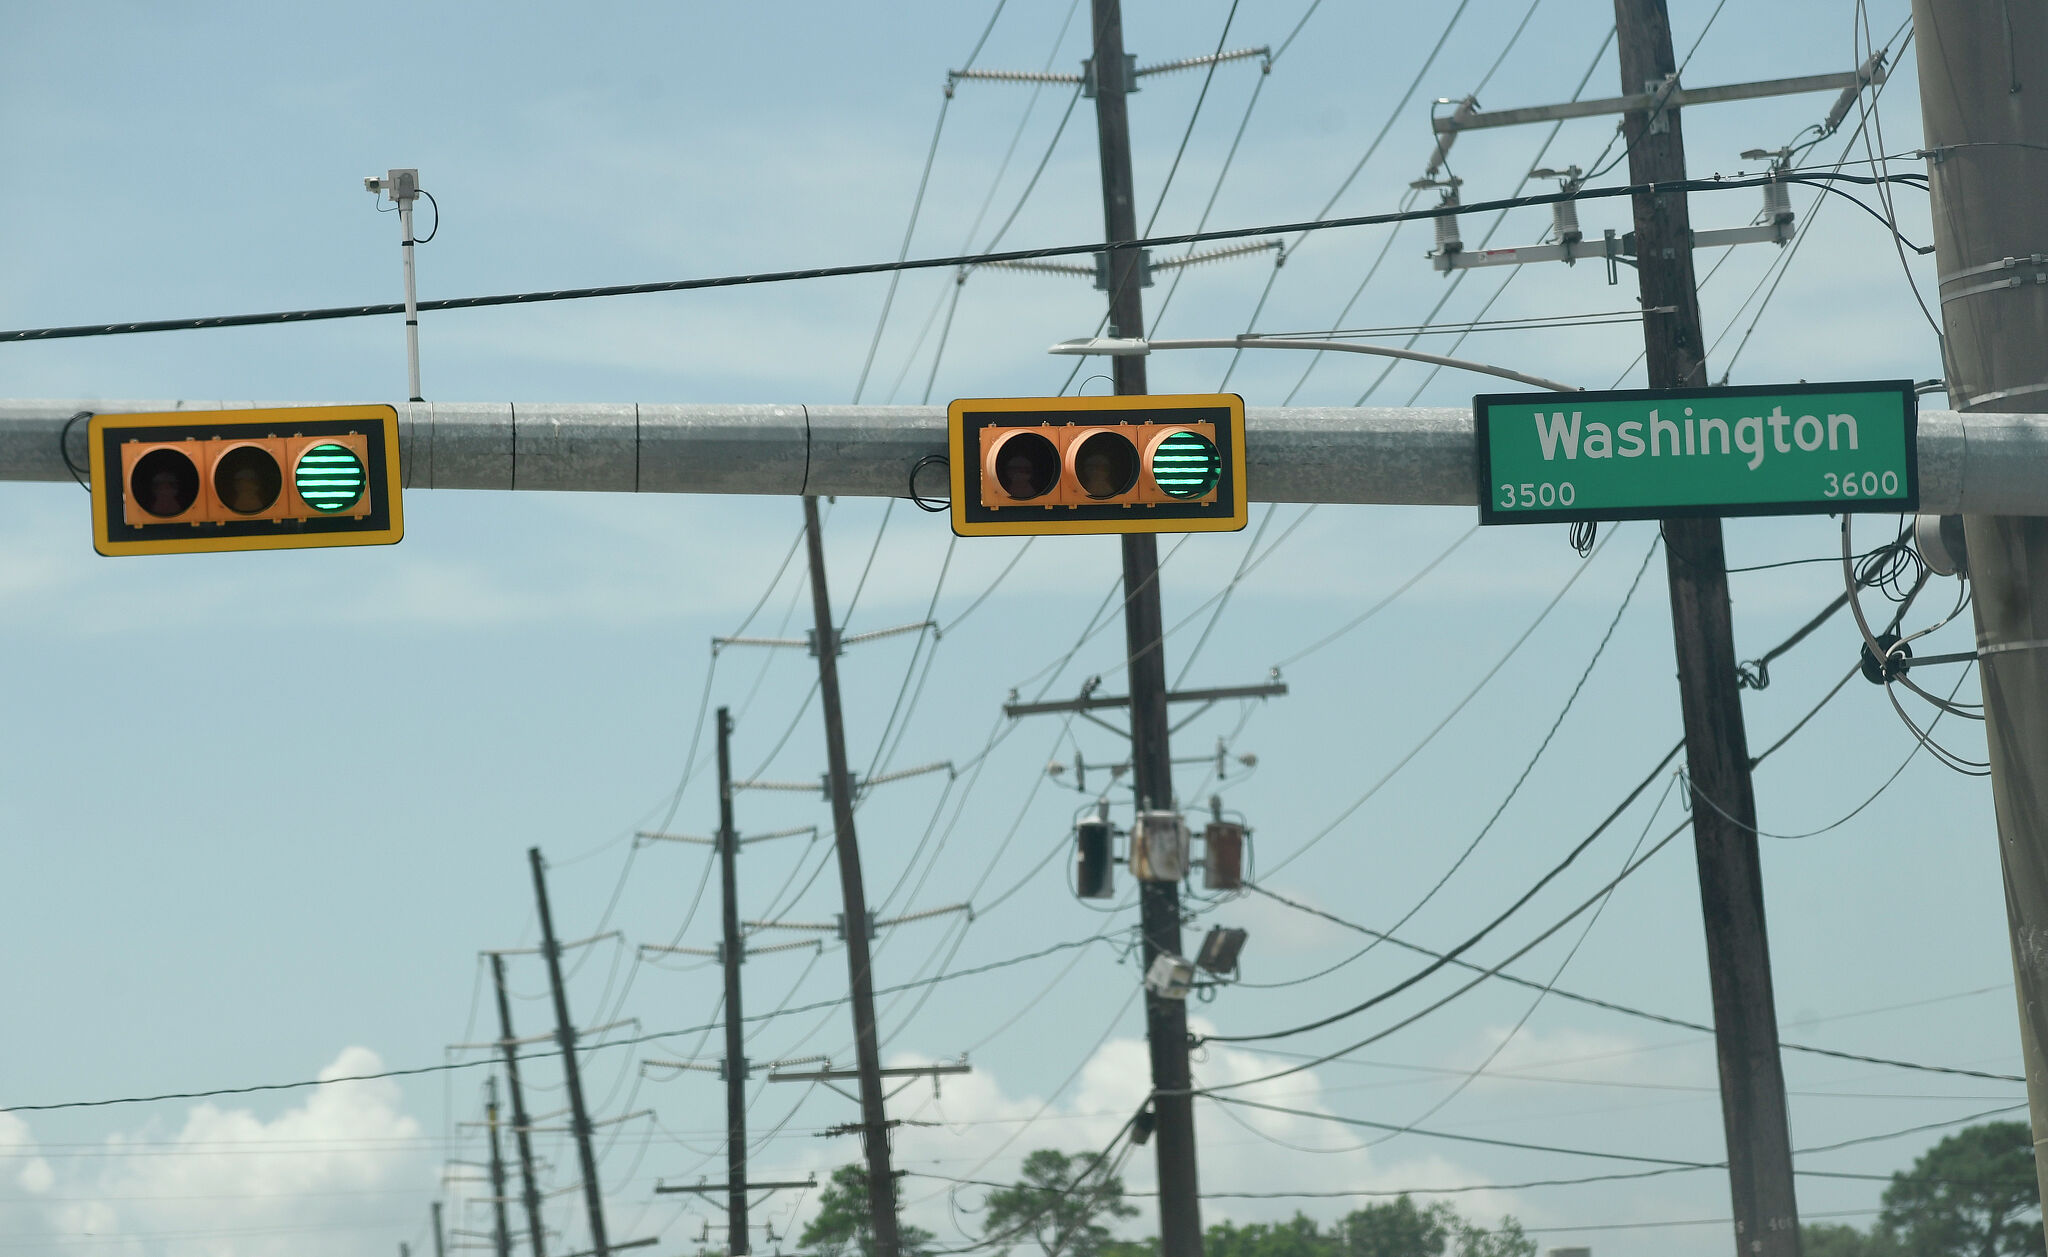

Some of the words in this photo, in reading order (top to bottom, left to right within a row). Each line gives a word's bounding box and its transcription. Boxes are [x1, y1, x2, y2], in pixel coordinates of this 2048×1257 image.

[1533, 406, 1859, 471] Washington
[1500, 481, 1576, 508] 3500
[1823, 470, 1899, 497] 3600
